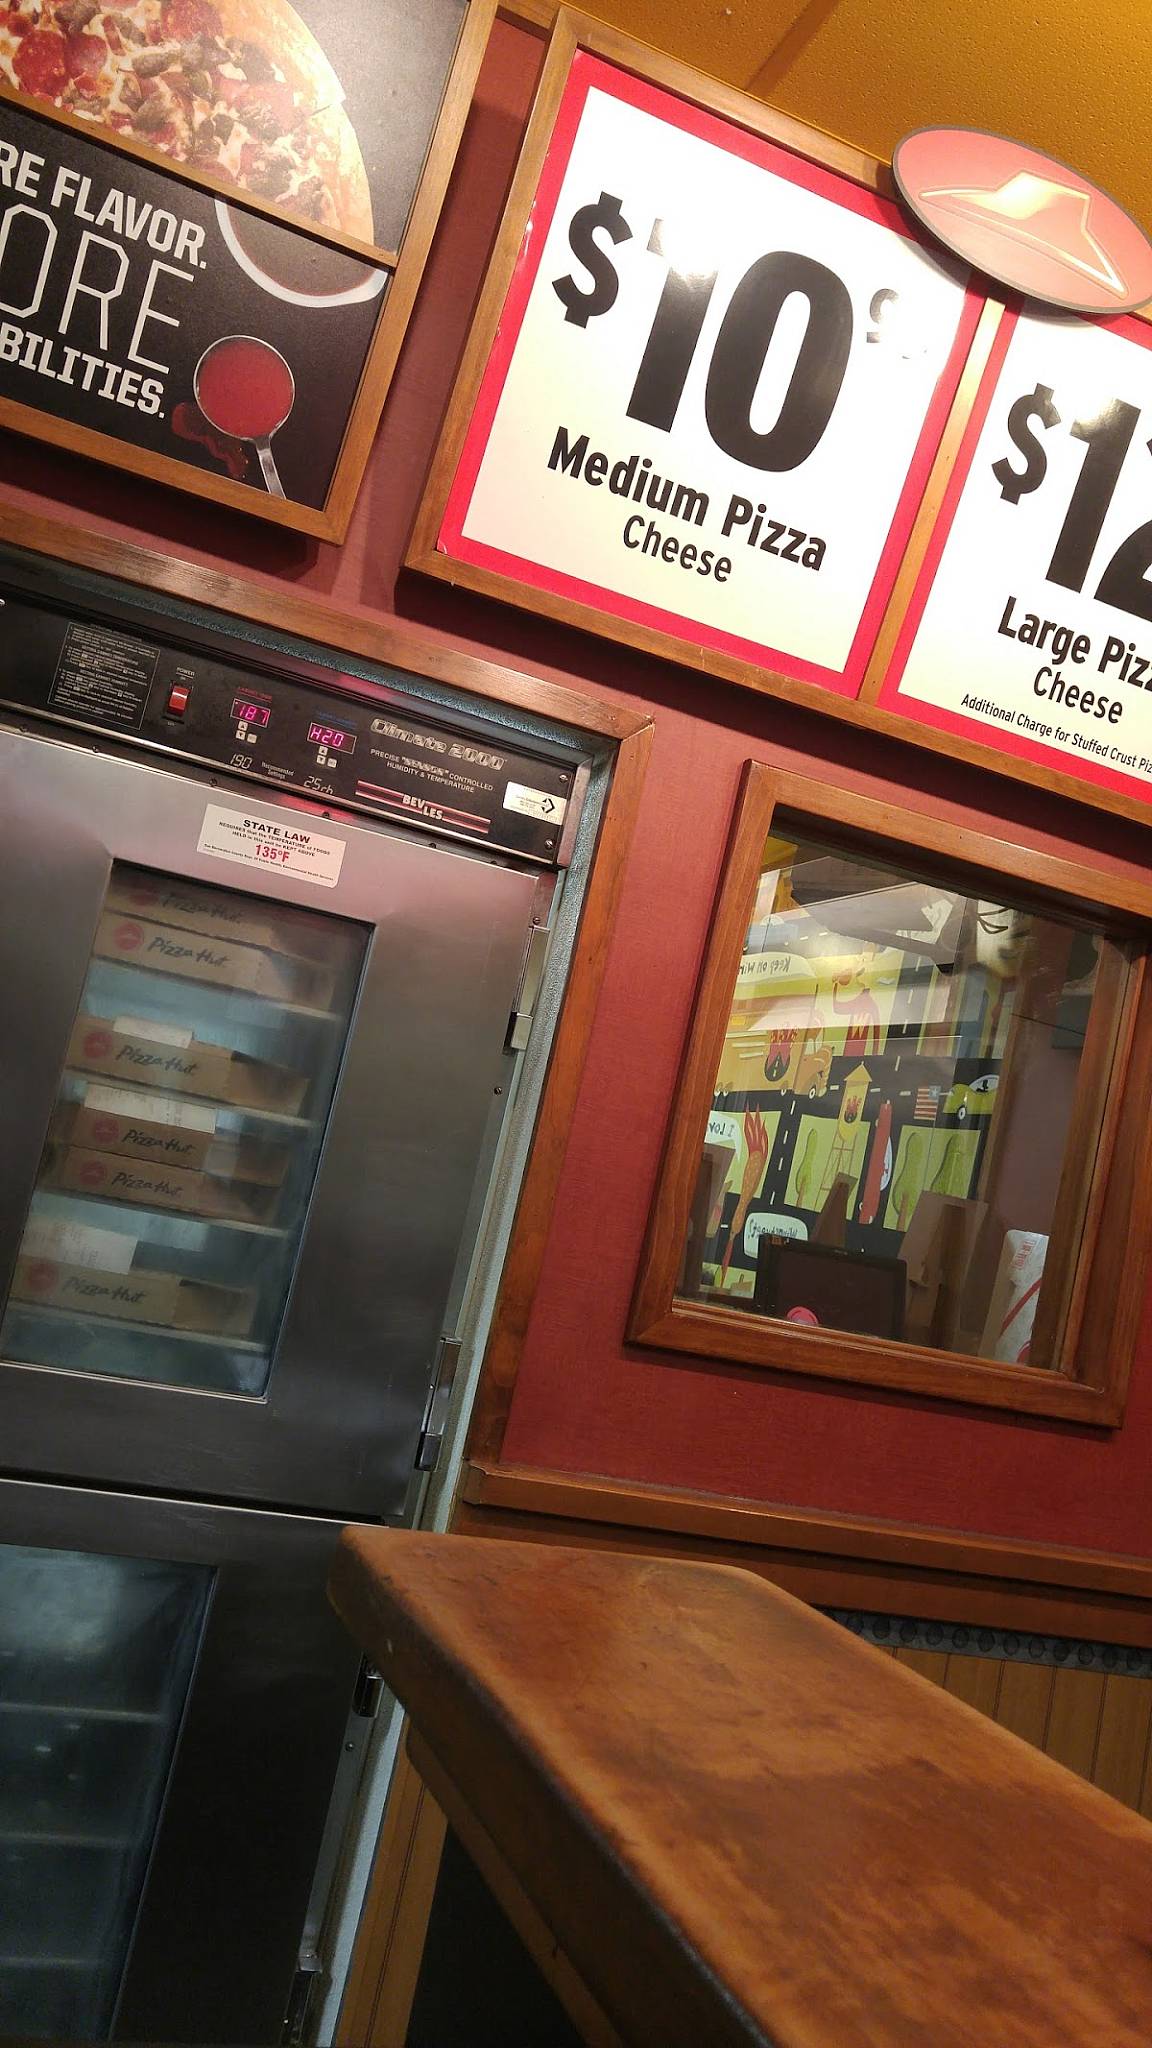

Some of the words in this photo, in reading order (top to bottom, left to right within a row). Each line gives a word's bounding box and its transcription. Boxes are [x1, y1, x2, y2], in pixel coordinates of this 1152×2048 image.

[51, 165, 208, 269] FLAVOR.
[0, 321, 165, 419] BILITIES.
[547, 426, 710, 527] Medium
[721, 494, 827, 572] Pizza
[623, 515, 732, 583] Cheese
[998, 596, 1091, 666] Large
[1033, 666, 1123, 724] Cheese
[239, 705, 269, 724] 187
[961, 694, 1015, 724] Additional
[1017, 713, 1053, 737] Charge
[1055, 725, 1070, 743] for
[1071, 732, 1109, 757] Stuffed
[1110, 742, 1137, 767] Crust
[230, 753, 253, 769] 190
[370, 748, 400, 763] PRECISE
[449, 773, 494, 791] CONTROLLED
[448, 743, 505, 770] 2000
[386, 761, 419, 776] HUMIDITY
[427, 774, 475, 793] TEMPERATURE
[243, 819, 281, 836] STATE
[284, 831, 311, 844] LAW
[148, 936, 193, 958] Pizza
[196, 949, 231, 966] Hut
[115, 1045, 162, 1066] Pizza
[165, 1057, 197, 1073] Hut
[122, 1129, 163, 1147] Pizza
[164, 1139, 194, 1153] Hut
[112, 1172, 153, 1189] Pizza
[154, 1180, 184, 1196] Hut
